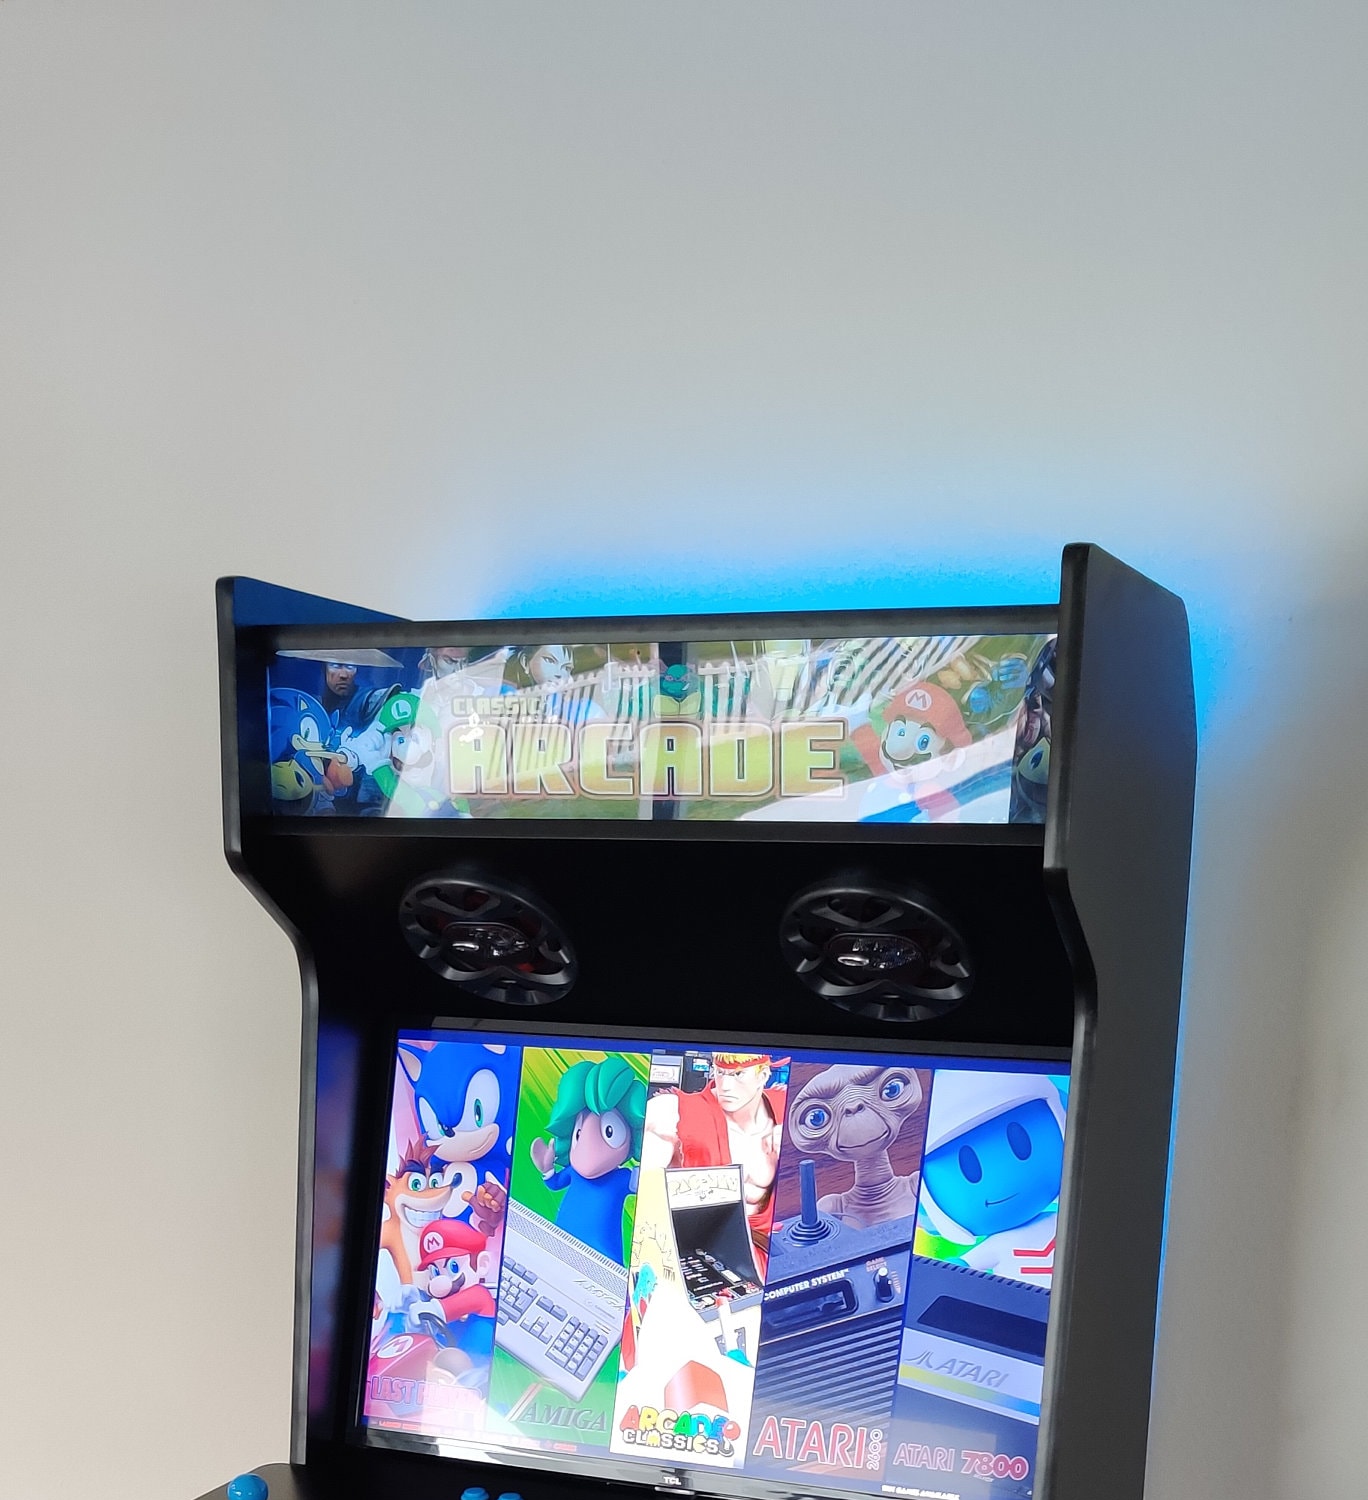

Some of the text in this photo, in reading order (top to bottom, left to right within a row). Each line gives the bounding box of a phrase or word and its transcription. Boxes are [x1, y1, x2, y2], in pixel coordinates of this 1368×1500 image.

[395, 702, 409, 717] L
[907, 691, 928, 709] M
[448, 719, 846, 798] ARCADE
[427, 1236, 441, 1250] M
[764, 1280, 811, 1301] COMPUTER
[933, 1358, 1011, 1389] ATARI
[371, 1376, 415, 1405] LAST
[518, 1402, 607, 1432] AMIGA
[620, 1405, 729, 1439] ARCADE
[753, 1415, 867, 1469] ATARI
[866, 1428, 883, 1471] 2600
[893, 1442, 1029, 1481] ATARI 7800
[663, 1476, 682, 1485] TCL
